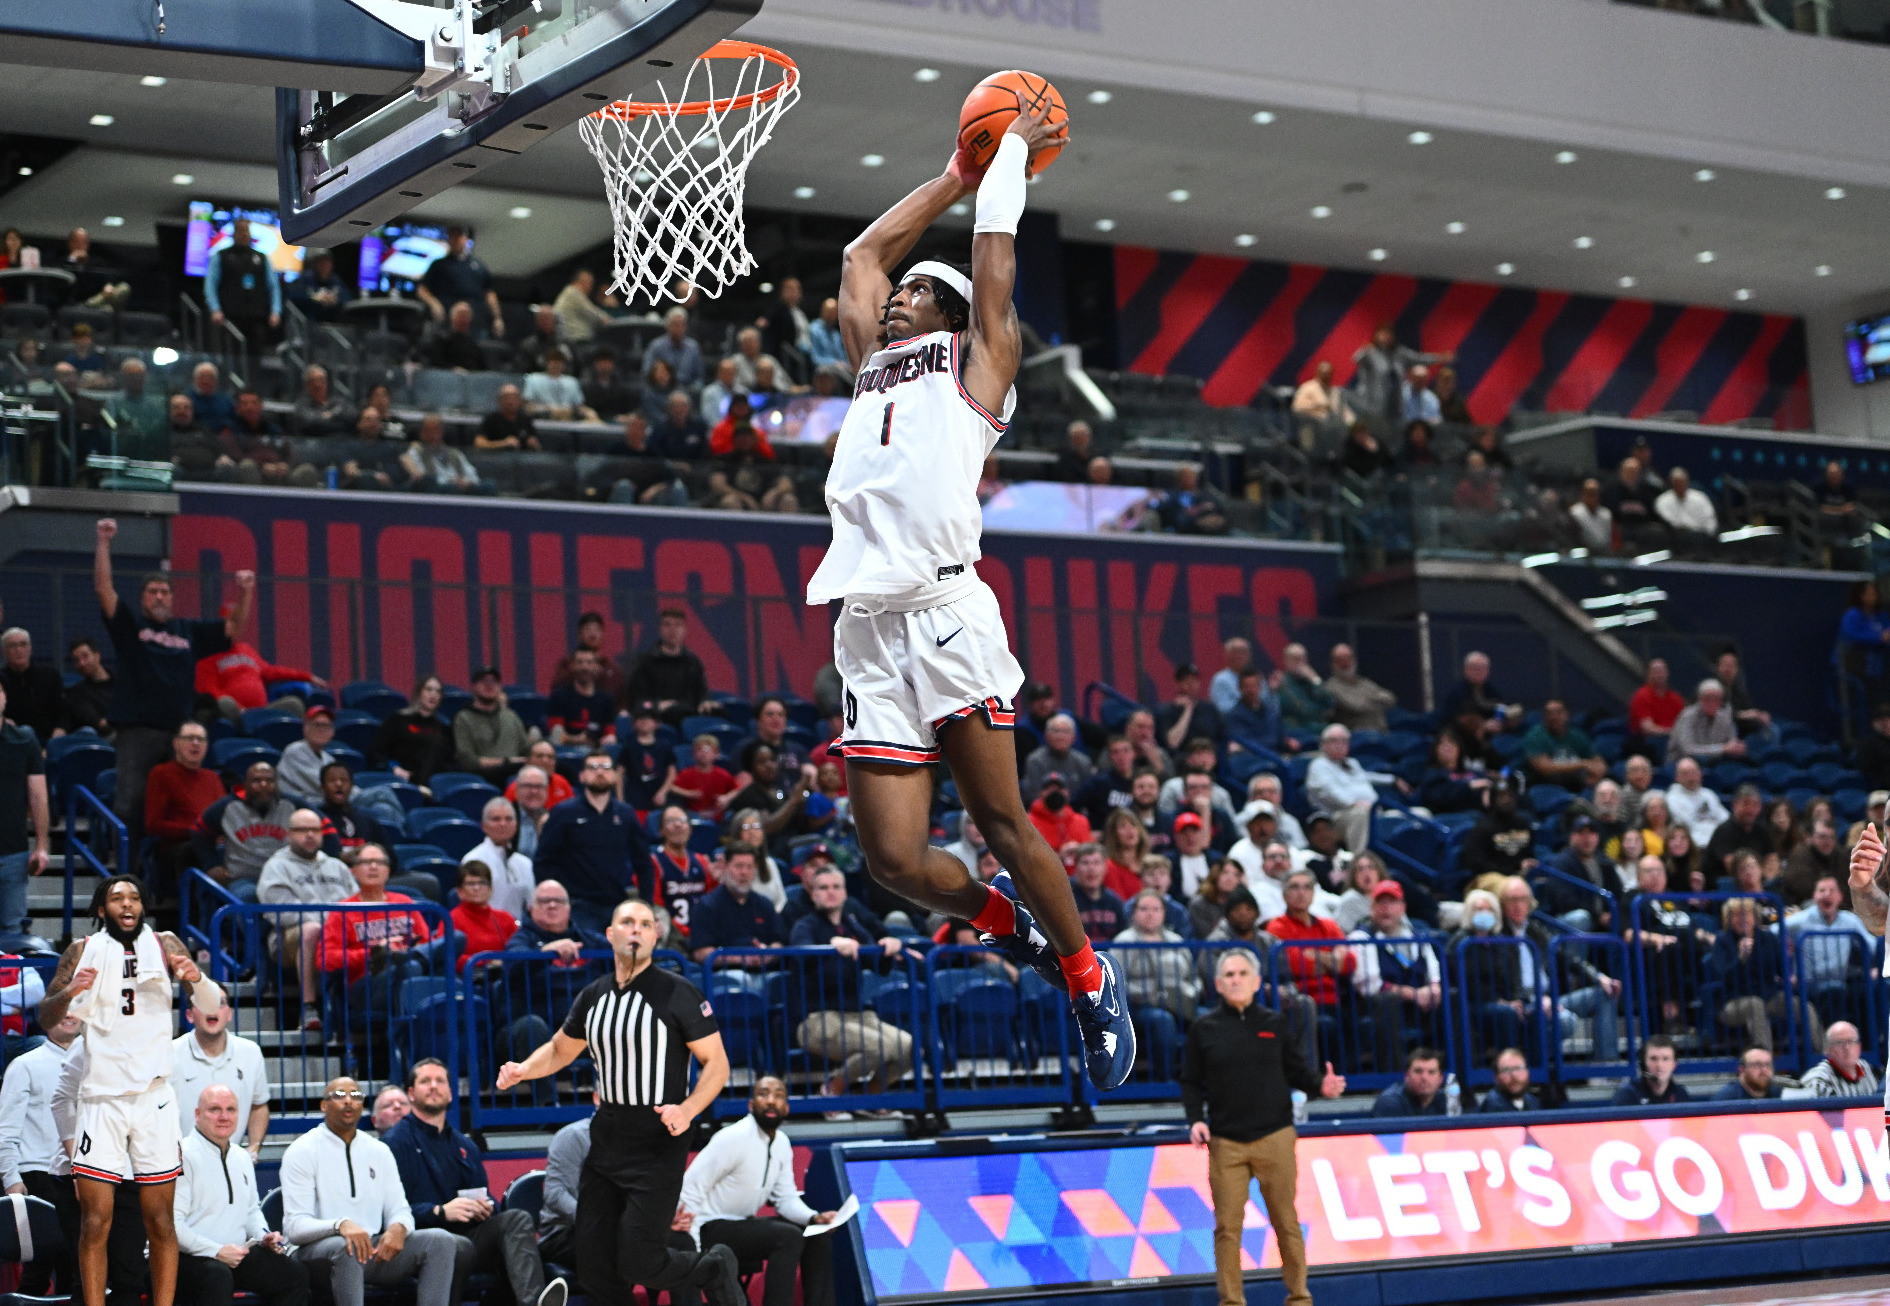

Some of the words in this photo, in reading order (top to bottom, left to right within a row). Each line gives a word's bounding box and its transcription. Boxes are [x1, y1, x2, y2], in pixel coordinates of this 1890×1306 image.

[855, 342, 949, 401] DUQUESNE
[880, 401, 895, 447] 1
[171, 513, 834, 704] DUQUESN
[672, 898, 690, 927] 3
[121, 987, 136, 1017] 3
[1311, 1144, 1573, 1242] LET'S
[1591, 1136, 1724, 1221] GO
